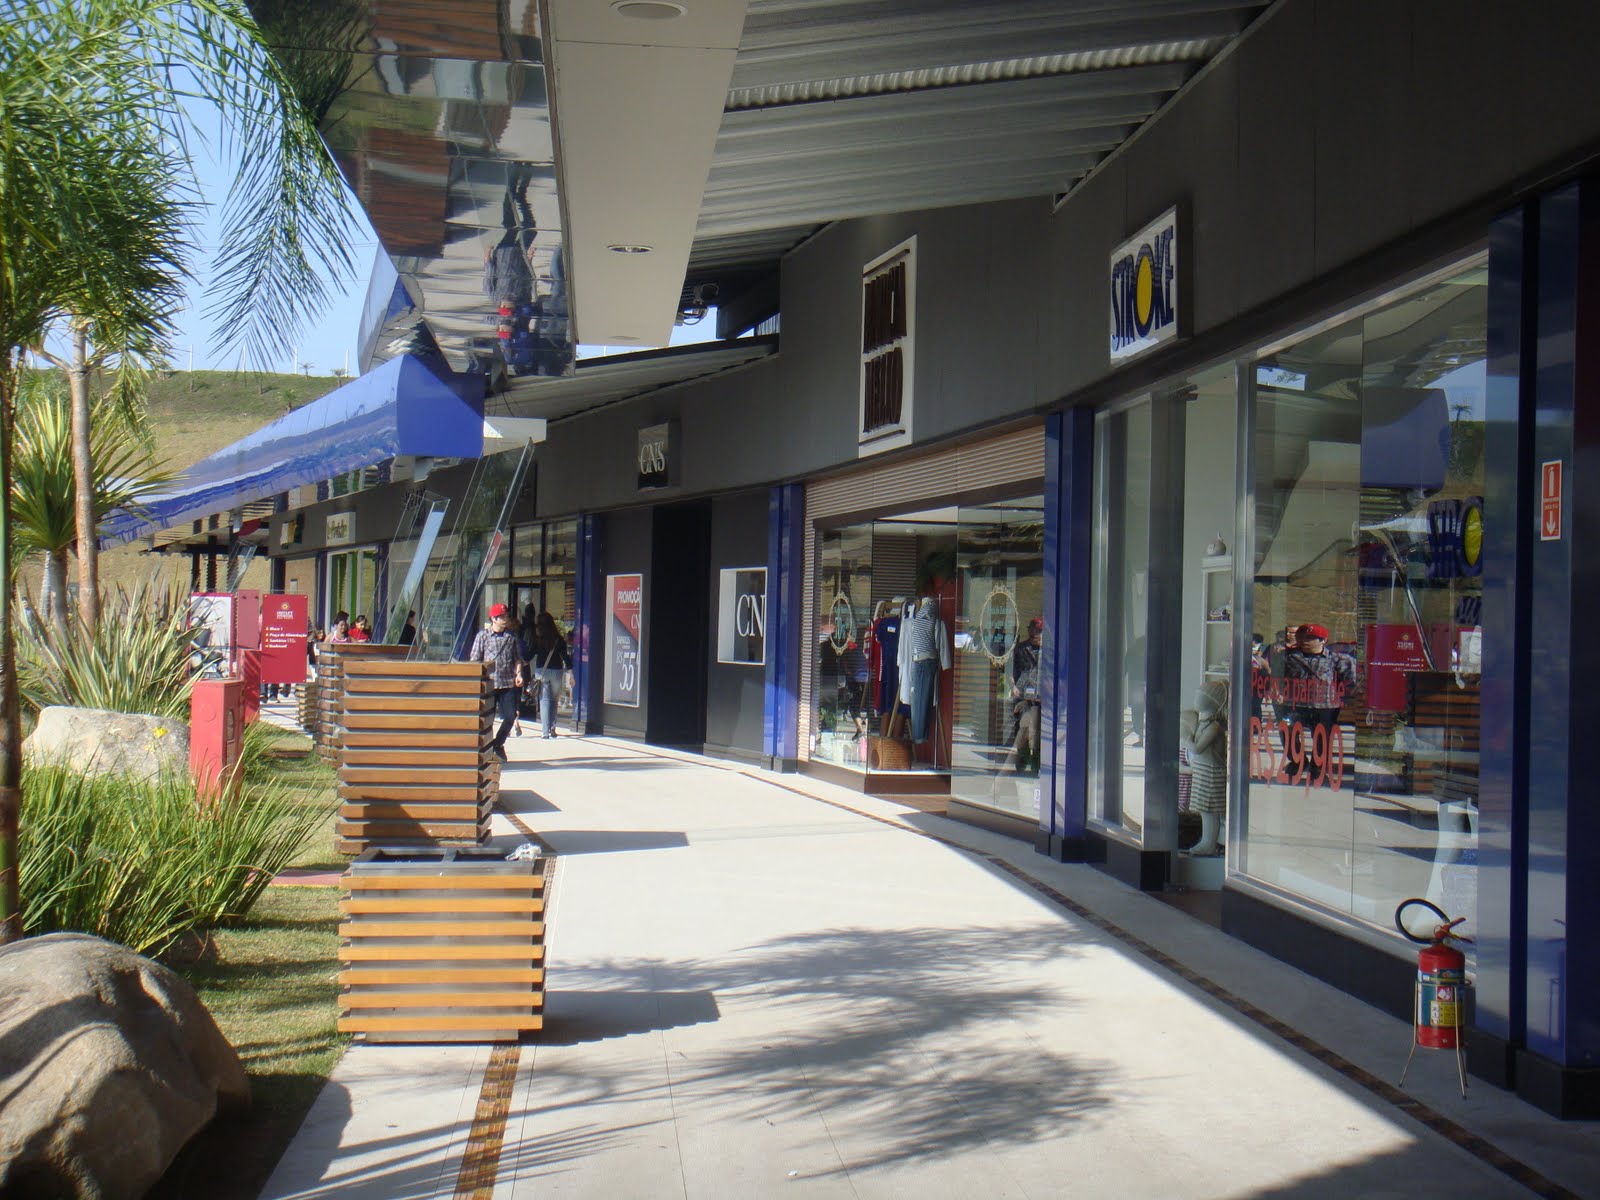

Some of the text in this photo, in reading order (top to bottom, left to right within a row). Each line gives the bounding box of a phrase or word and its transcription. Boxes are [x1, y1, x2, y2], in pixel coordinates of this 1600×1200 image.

[1111, 225, 1174, 352] STROKE
[640, 441, 665, 475] CNS
[1249, 715, 1344, 799] R$29,90
